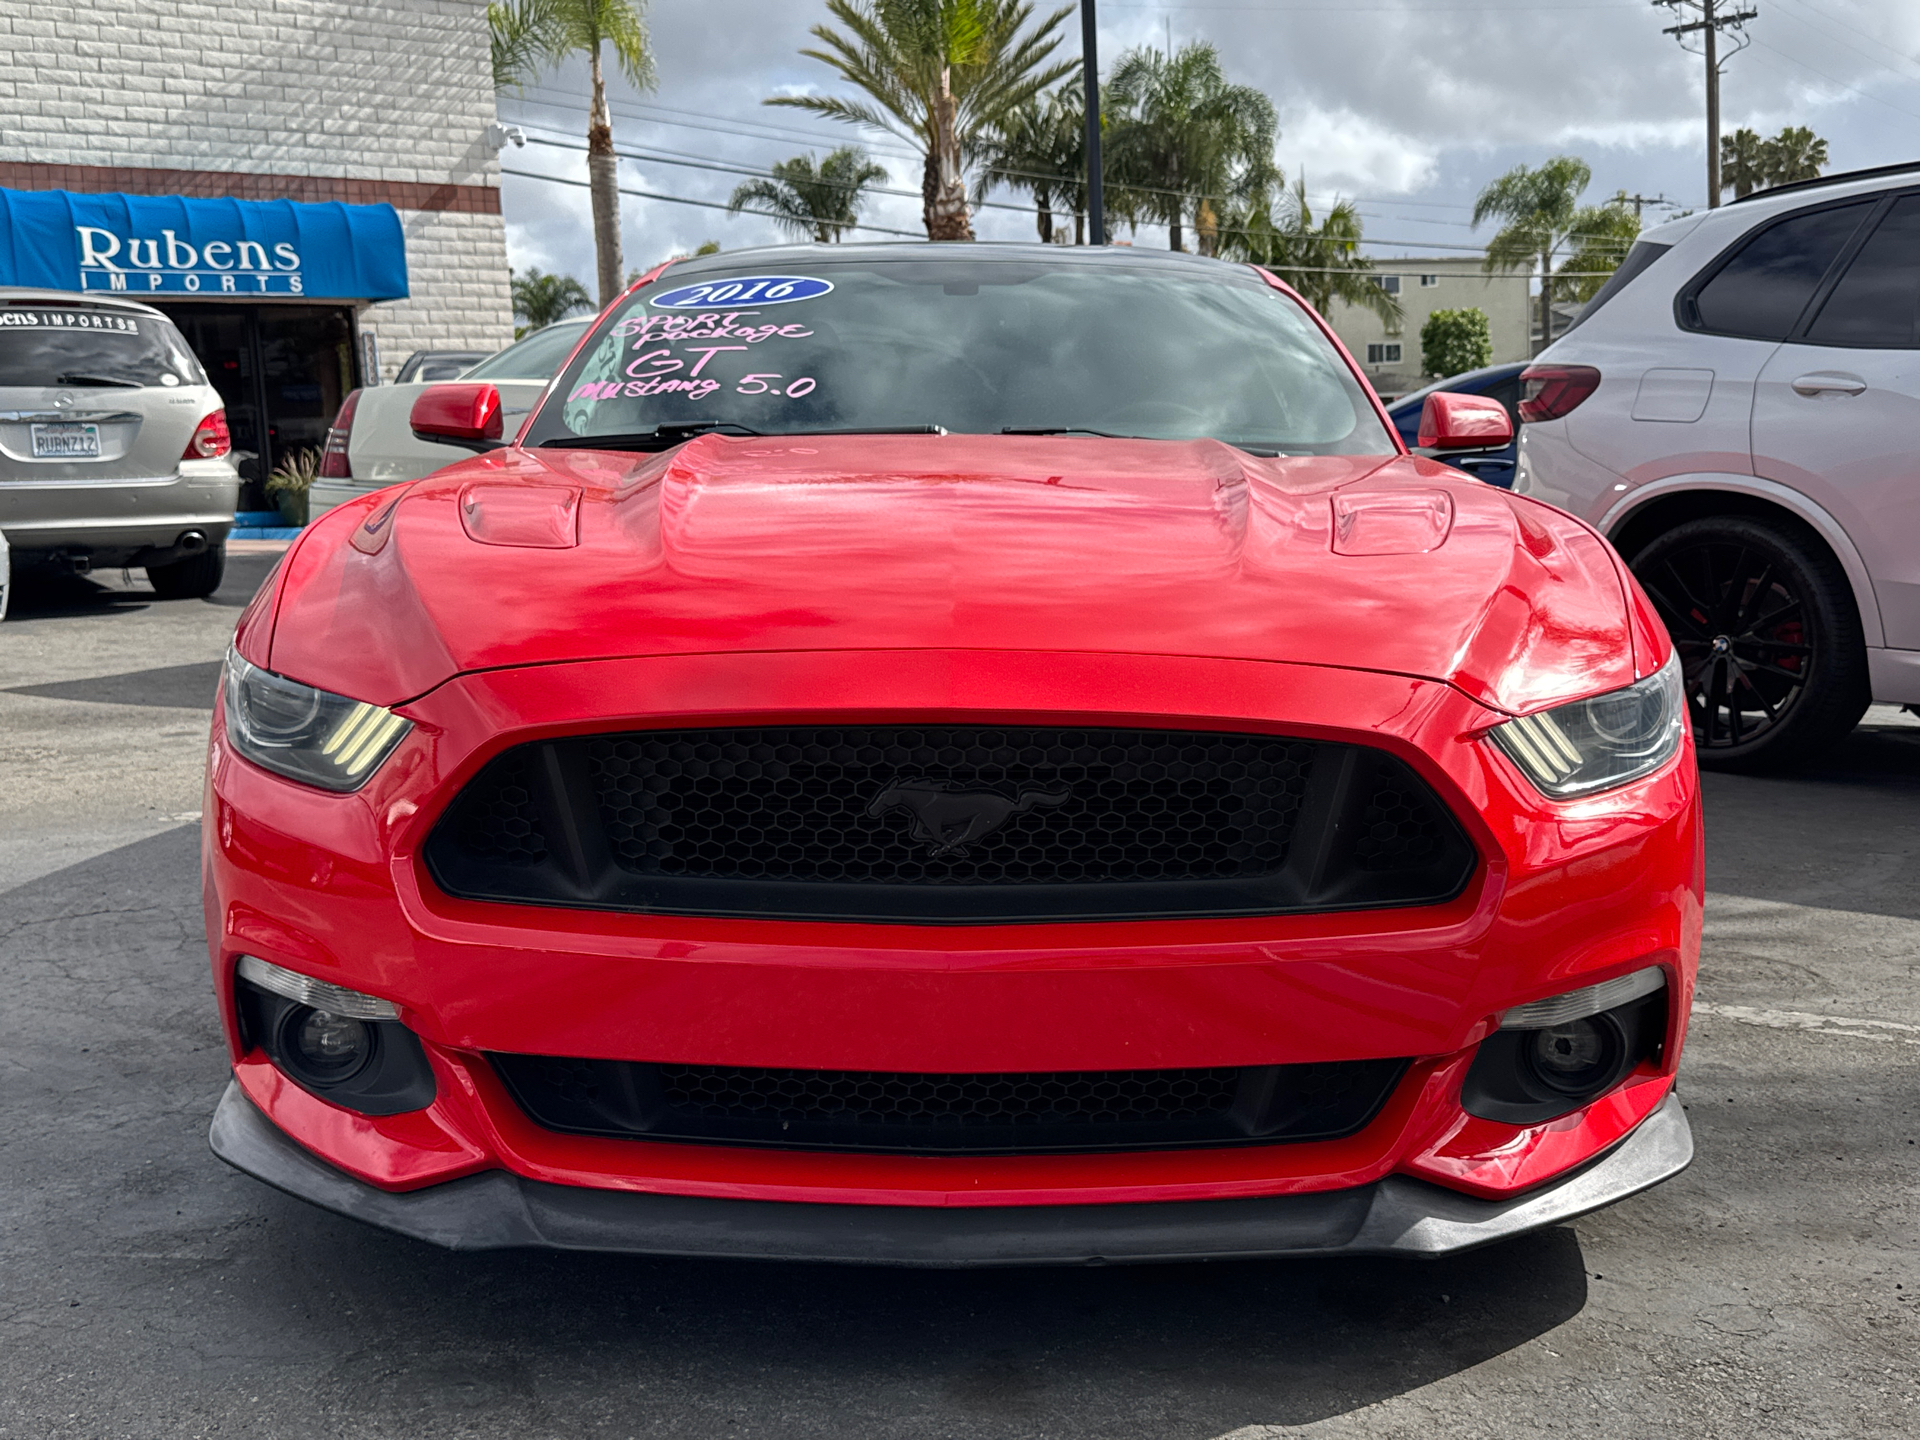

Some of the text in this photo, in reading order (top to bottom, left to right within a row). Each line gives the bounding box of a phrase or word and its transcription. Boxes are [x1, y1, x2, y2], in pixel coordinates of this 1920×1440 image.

[76, 226, 301, 273] Rubens
[81, 271, 303, 292] IMPORTS
[674, 279, 806, 307] 2016
[42, 313, 126, 330] IMPORTS
[609, 311, 761, 337] SPORT
[626, 346, 748, 379] GT
[736, 373, 817, 399] 5.0
[37, 436, 98, 452] RUBNZ12
